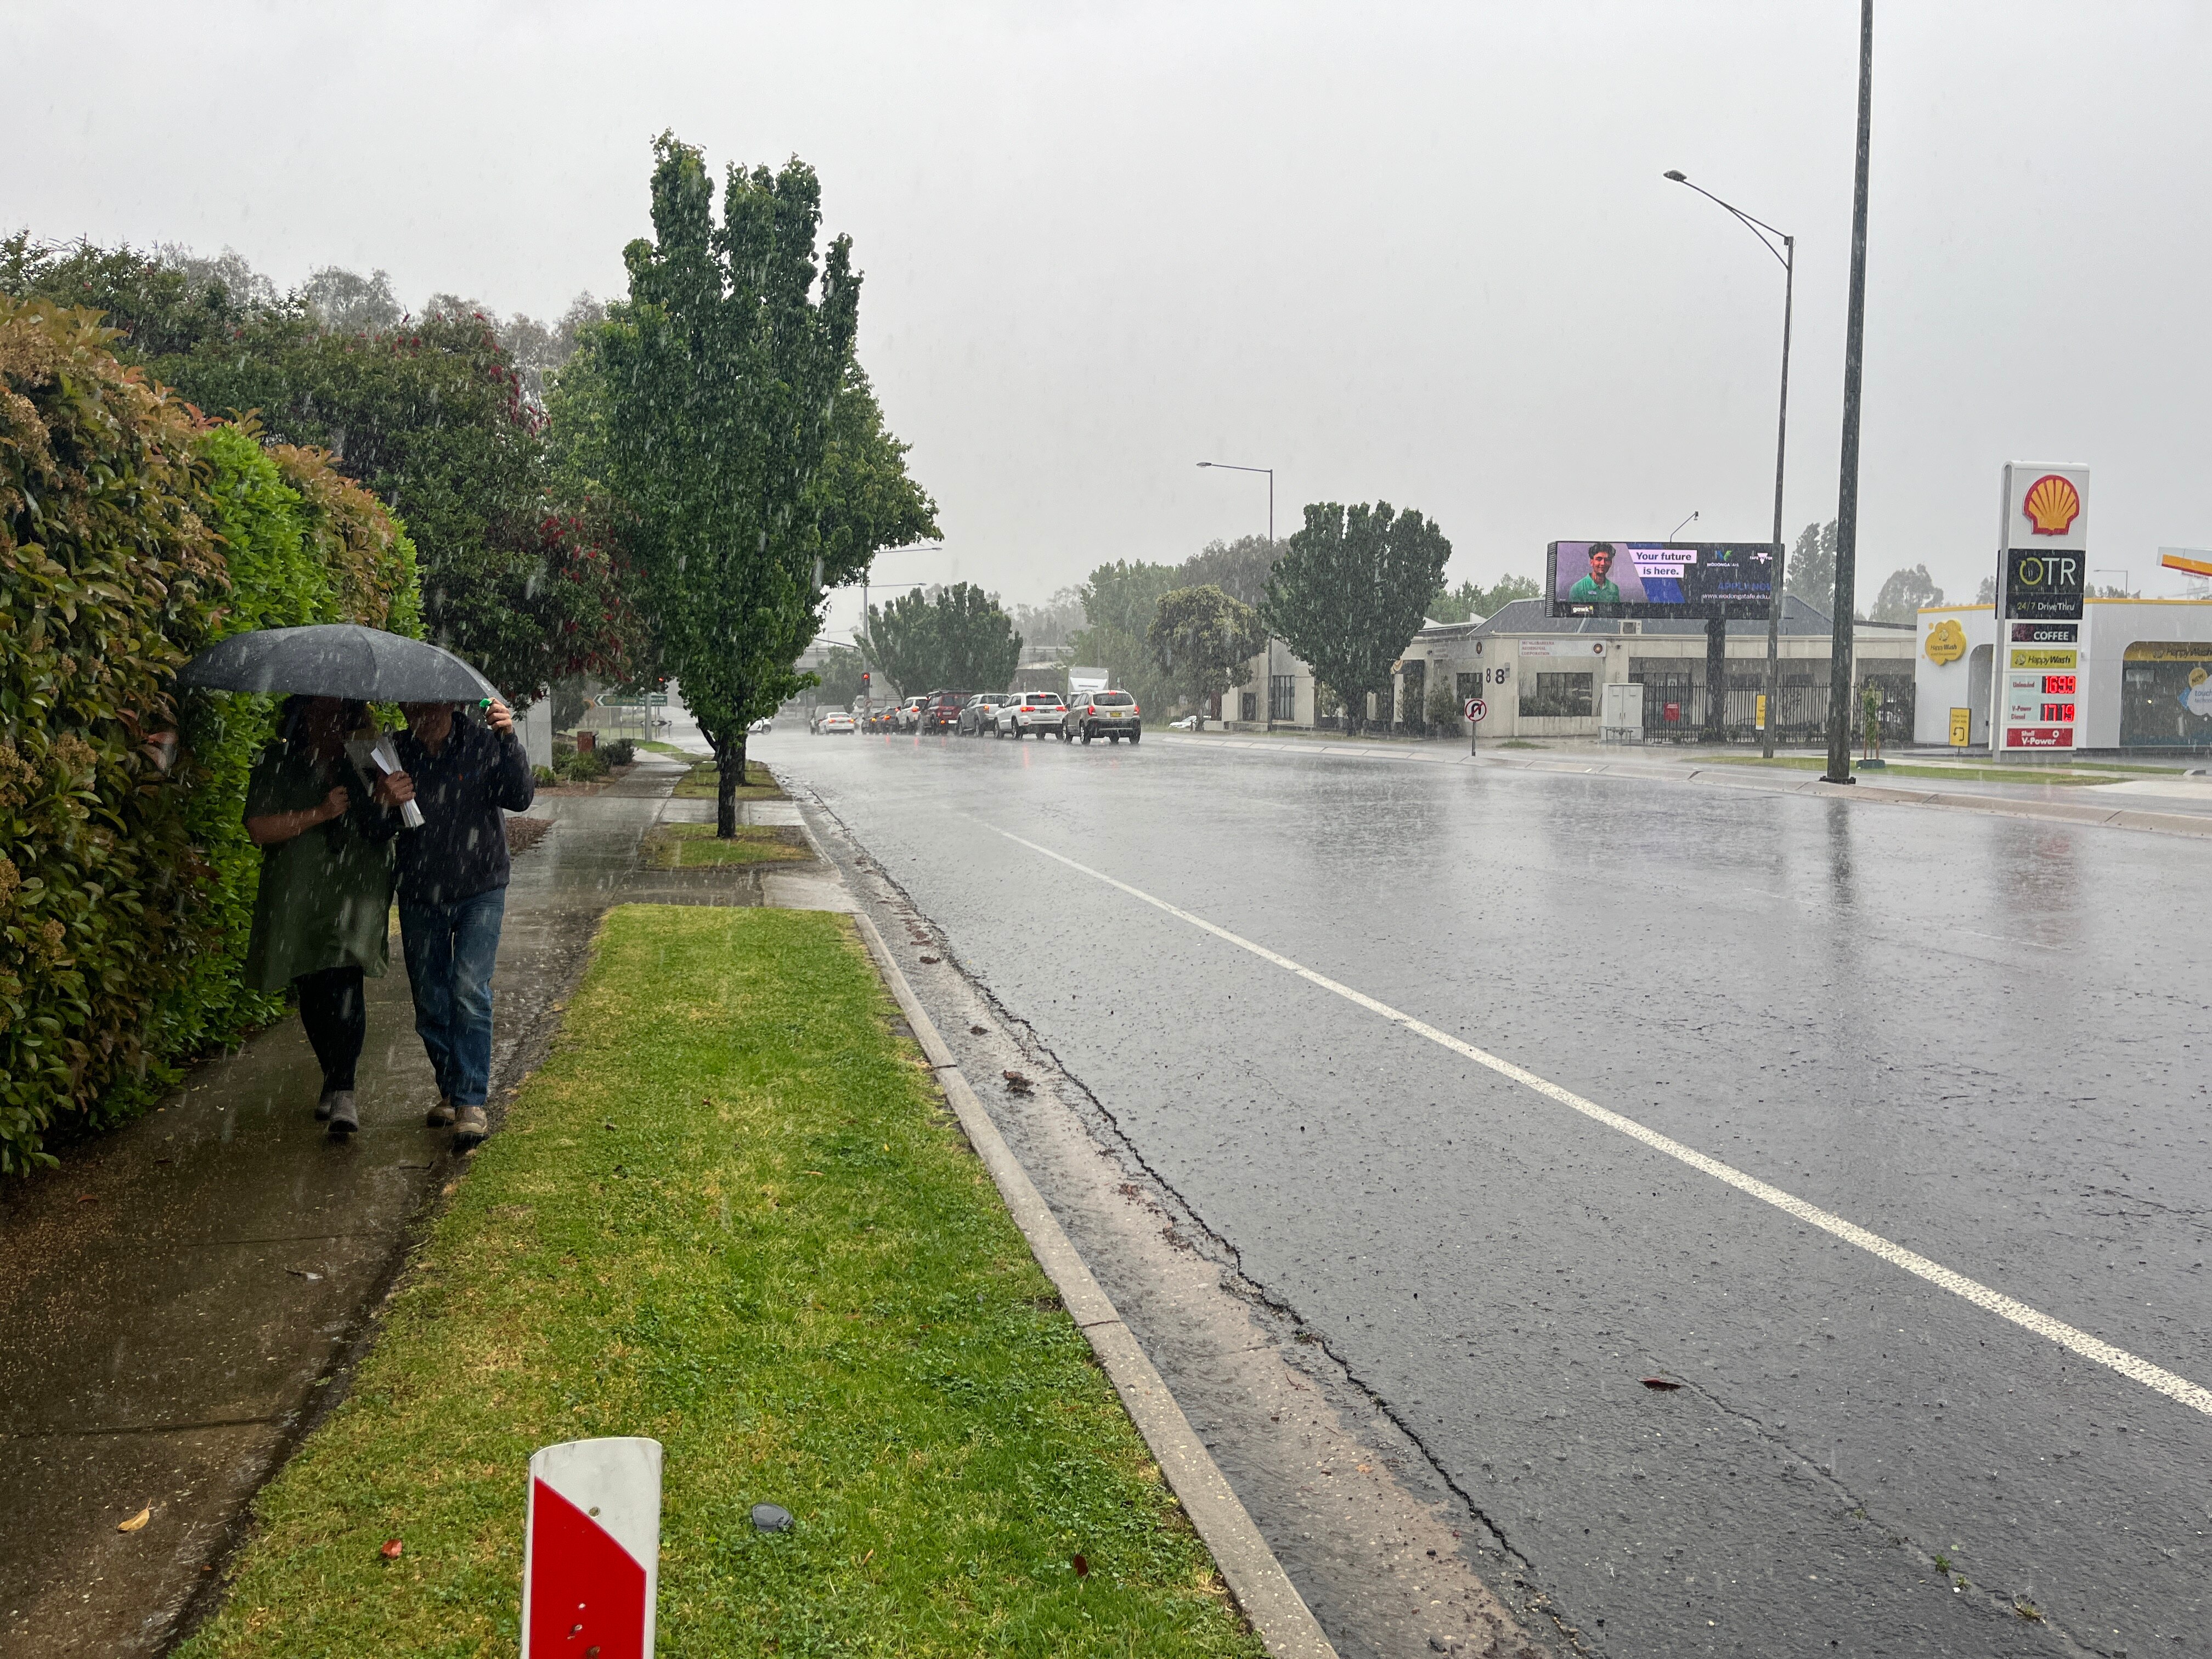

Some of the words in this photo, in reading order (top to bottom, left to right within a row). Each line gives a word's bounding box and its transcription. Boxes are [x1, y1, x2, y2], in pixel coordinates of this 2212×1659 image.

[1636, 552, 1658, 560] Your
[1643, 567, 1651, 575] is
[1654, 567, 1679, 575] here.
[2019, 557, 2076, 585] OTR
[2017, 602, 2036, 612] 24/7
[2033, 631, 2068, 641] COFFEE
[2022, 737, 2056, 745] V-Power
